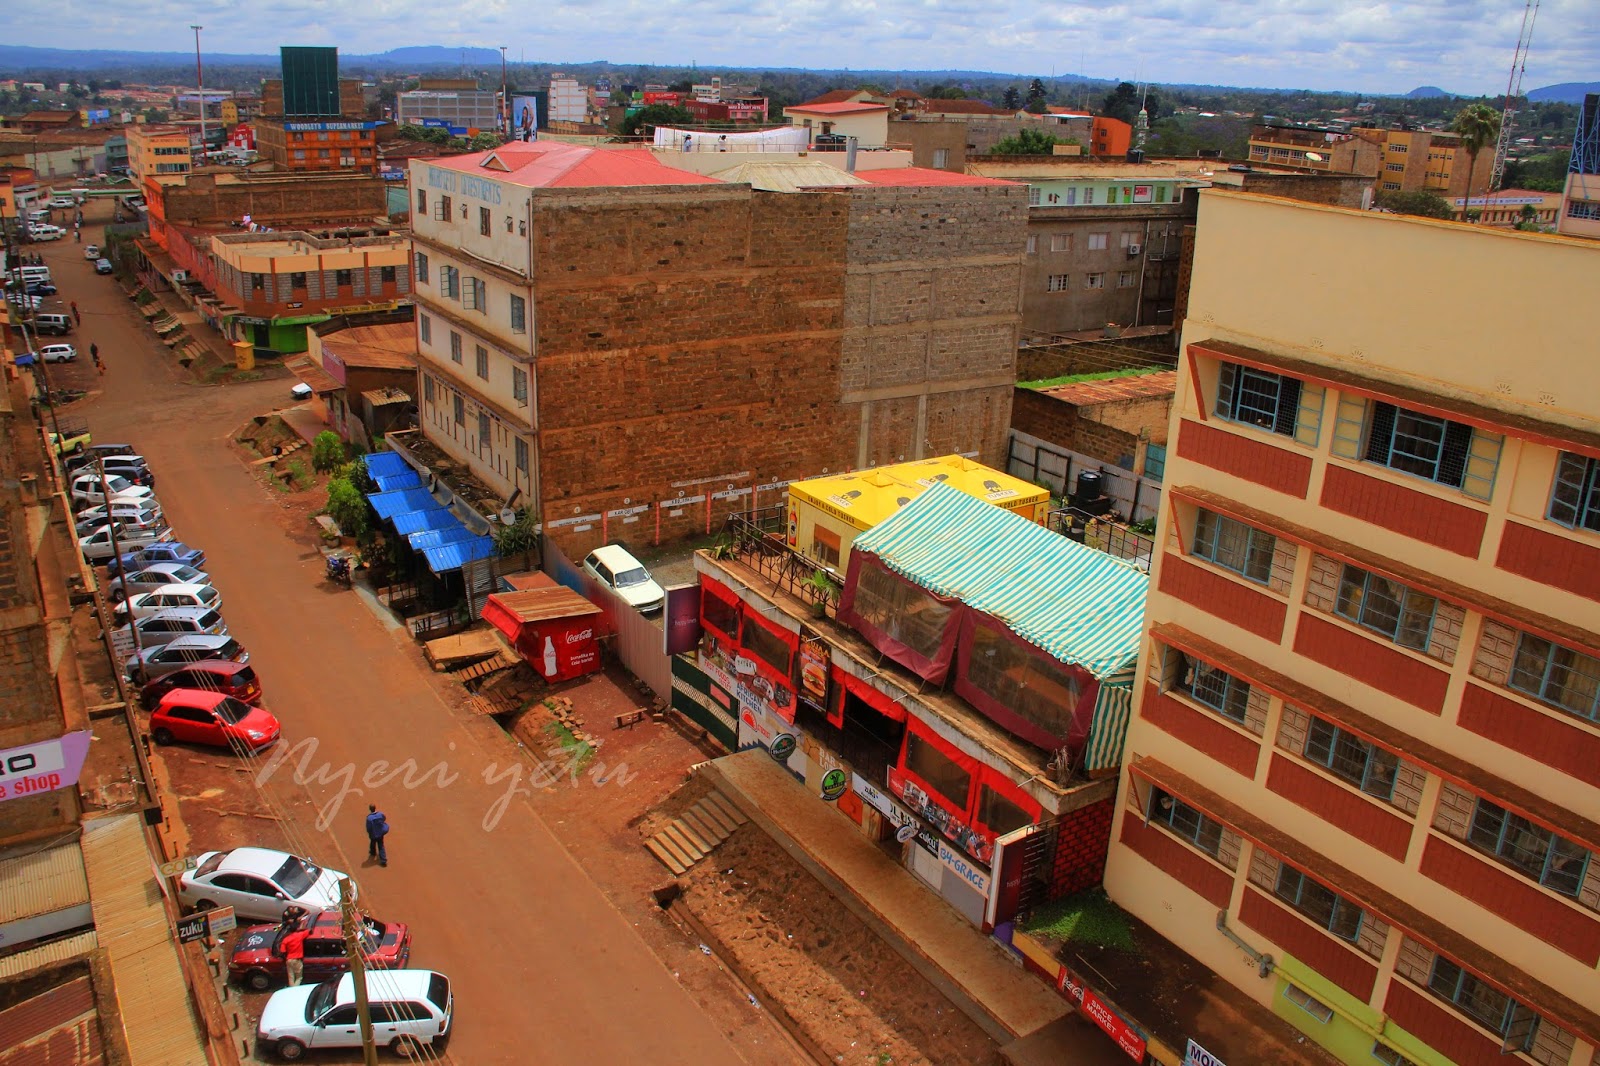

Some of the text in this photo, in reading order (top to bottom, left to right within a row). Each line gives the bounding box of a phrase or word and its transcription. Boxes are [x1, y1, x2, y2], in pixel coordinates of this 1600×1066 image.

[326, 122, 364, 130] SUPERMARKET
[988, 490, 1014, 500] TUSKER
[1004, 501, 1017, 509] COLD
[1020, 496, 1038, 504] TUSKER
[808, 495, 821, 507] ENJOY
[825, 504, 837, 517] COLD
[837, 510, 855, 524] TUSKER
[736, 683, 762, 706] AFRICAN
[736, 690, 762, 715] KITCHEN
[819, 747, 836, 767] BAR
[14, 773, 61, 795] shop
[918, 831, 936, 849] zuku
[180, 922, 203, 937] zuku
[1086, 1003, 1116, 1034] MARKET
[1091, 999, 1113, 1023] SPICE
